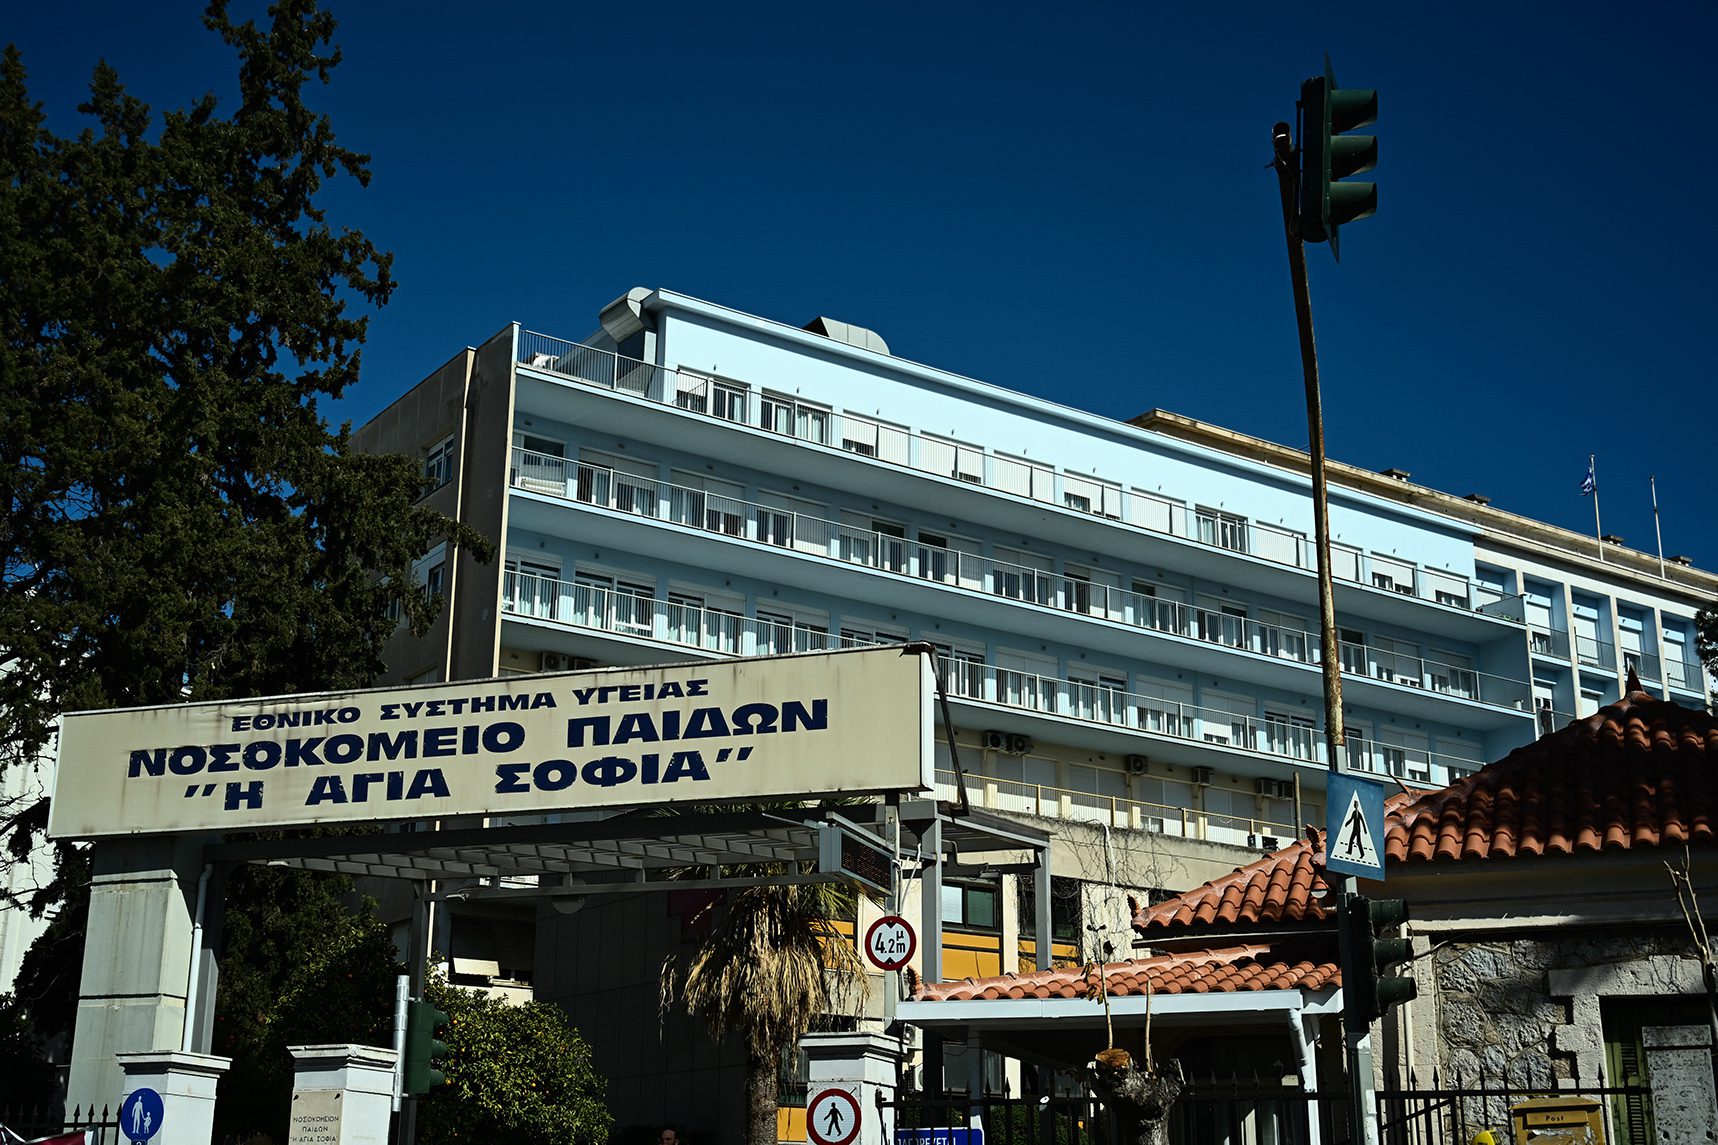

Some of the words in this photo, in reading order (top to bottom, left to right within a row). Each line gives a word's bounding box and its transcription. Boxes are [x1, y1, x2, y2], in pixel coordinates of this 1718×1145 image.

[231, 706, 361, 732] ΕΘΝΙΚΟ
[380, 692, 557, 720] ΣΥΣΤΗΜΑ
[572, 679, 709, 706] ΥΓΕΙΑΣ
[128, 722, 526, 778] ΝΟΣΟΚΟΜΕΙΟ
[567, 699, 828, 748] ΠΑΙΔΩΝ
[305, 768, 451, 806] ΑΓΙΑ
